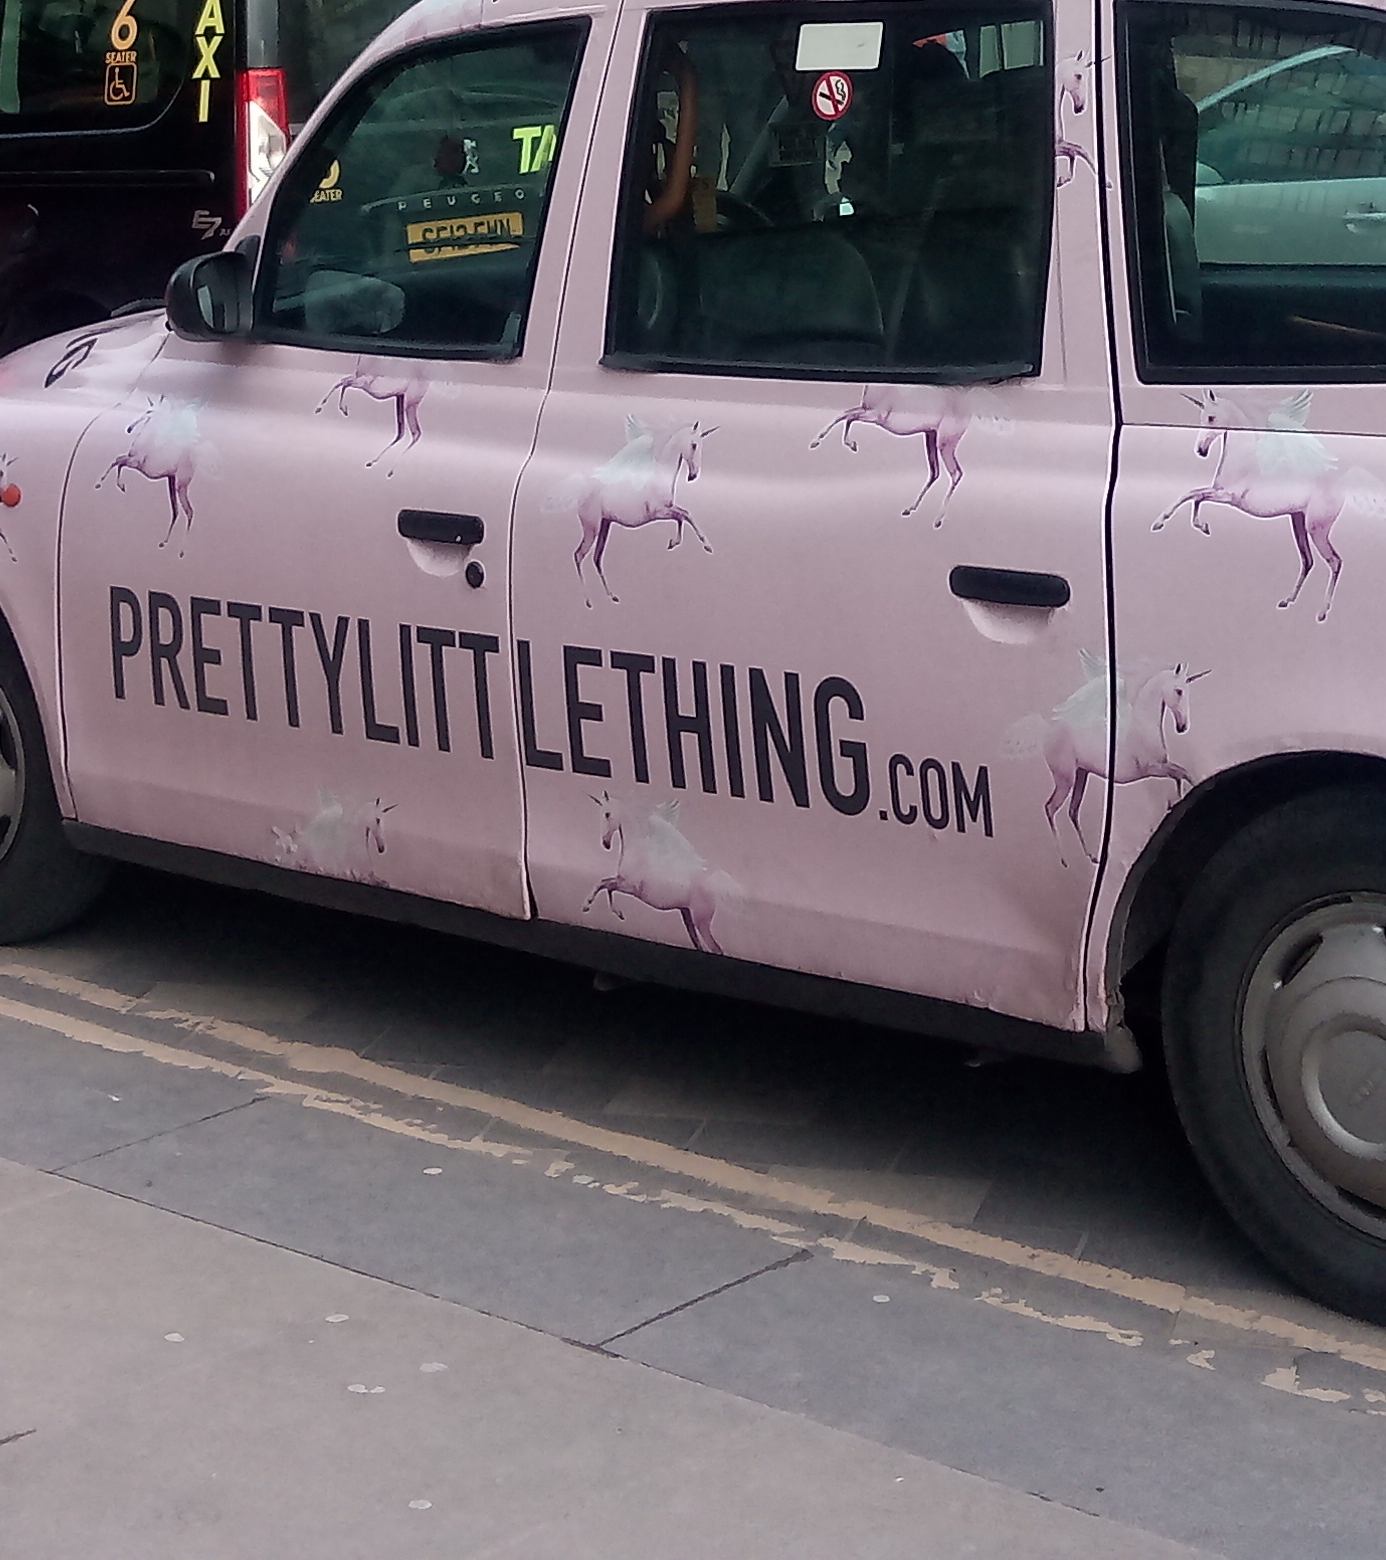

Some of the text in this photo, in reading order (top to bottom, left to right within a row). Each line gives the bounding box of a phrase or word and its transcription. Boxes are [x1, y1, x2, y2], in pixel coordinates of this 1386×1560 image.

[105, 51, 138, 64] SEATER
[513, 124, 557, 175] TA
[398, 189, 544, 211] PEUGEO
[109, 586, 993, 838] PRETTYLITTLETHING.COM
